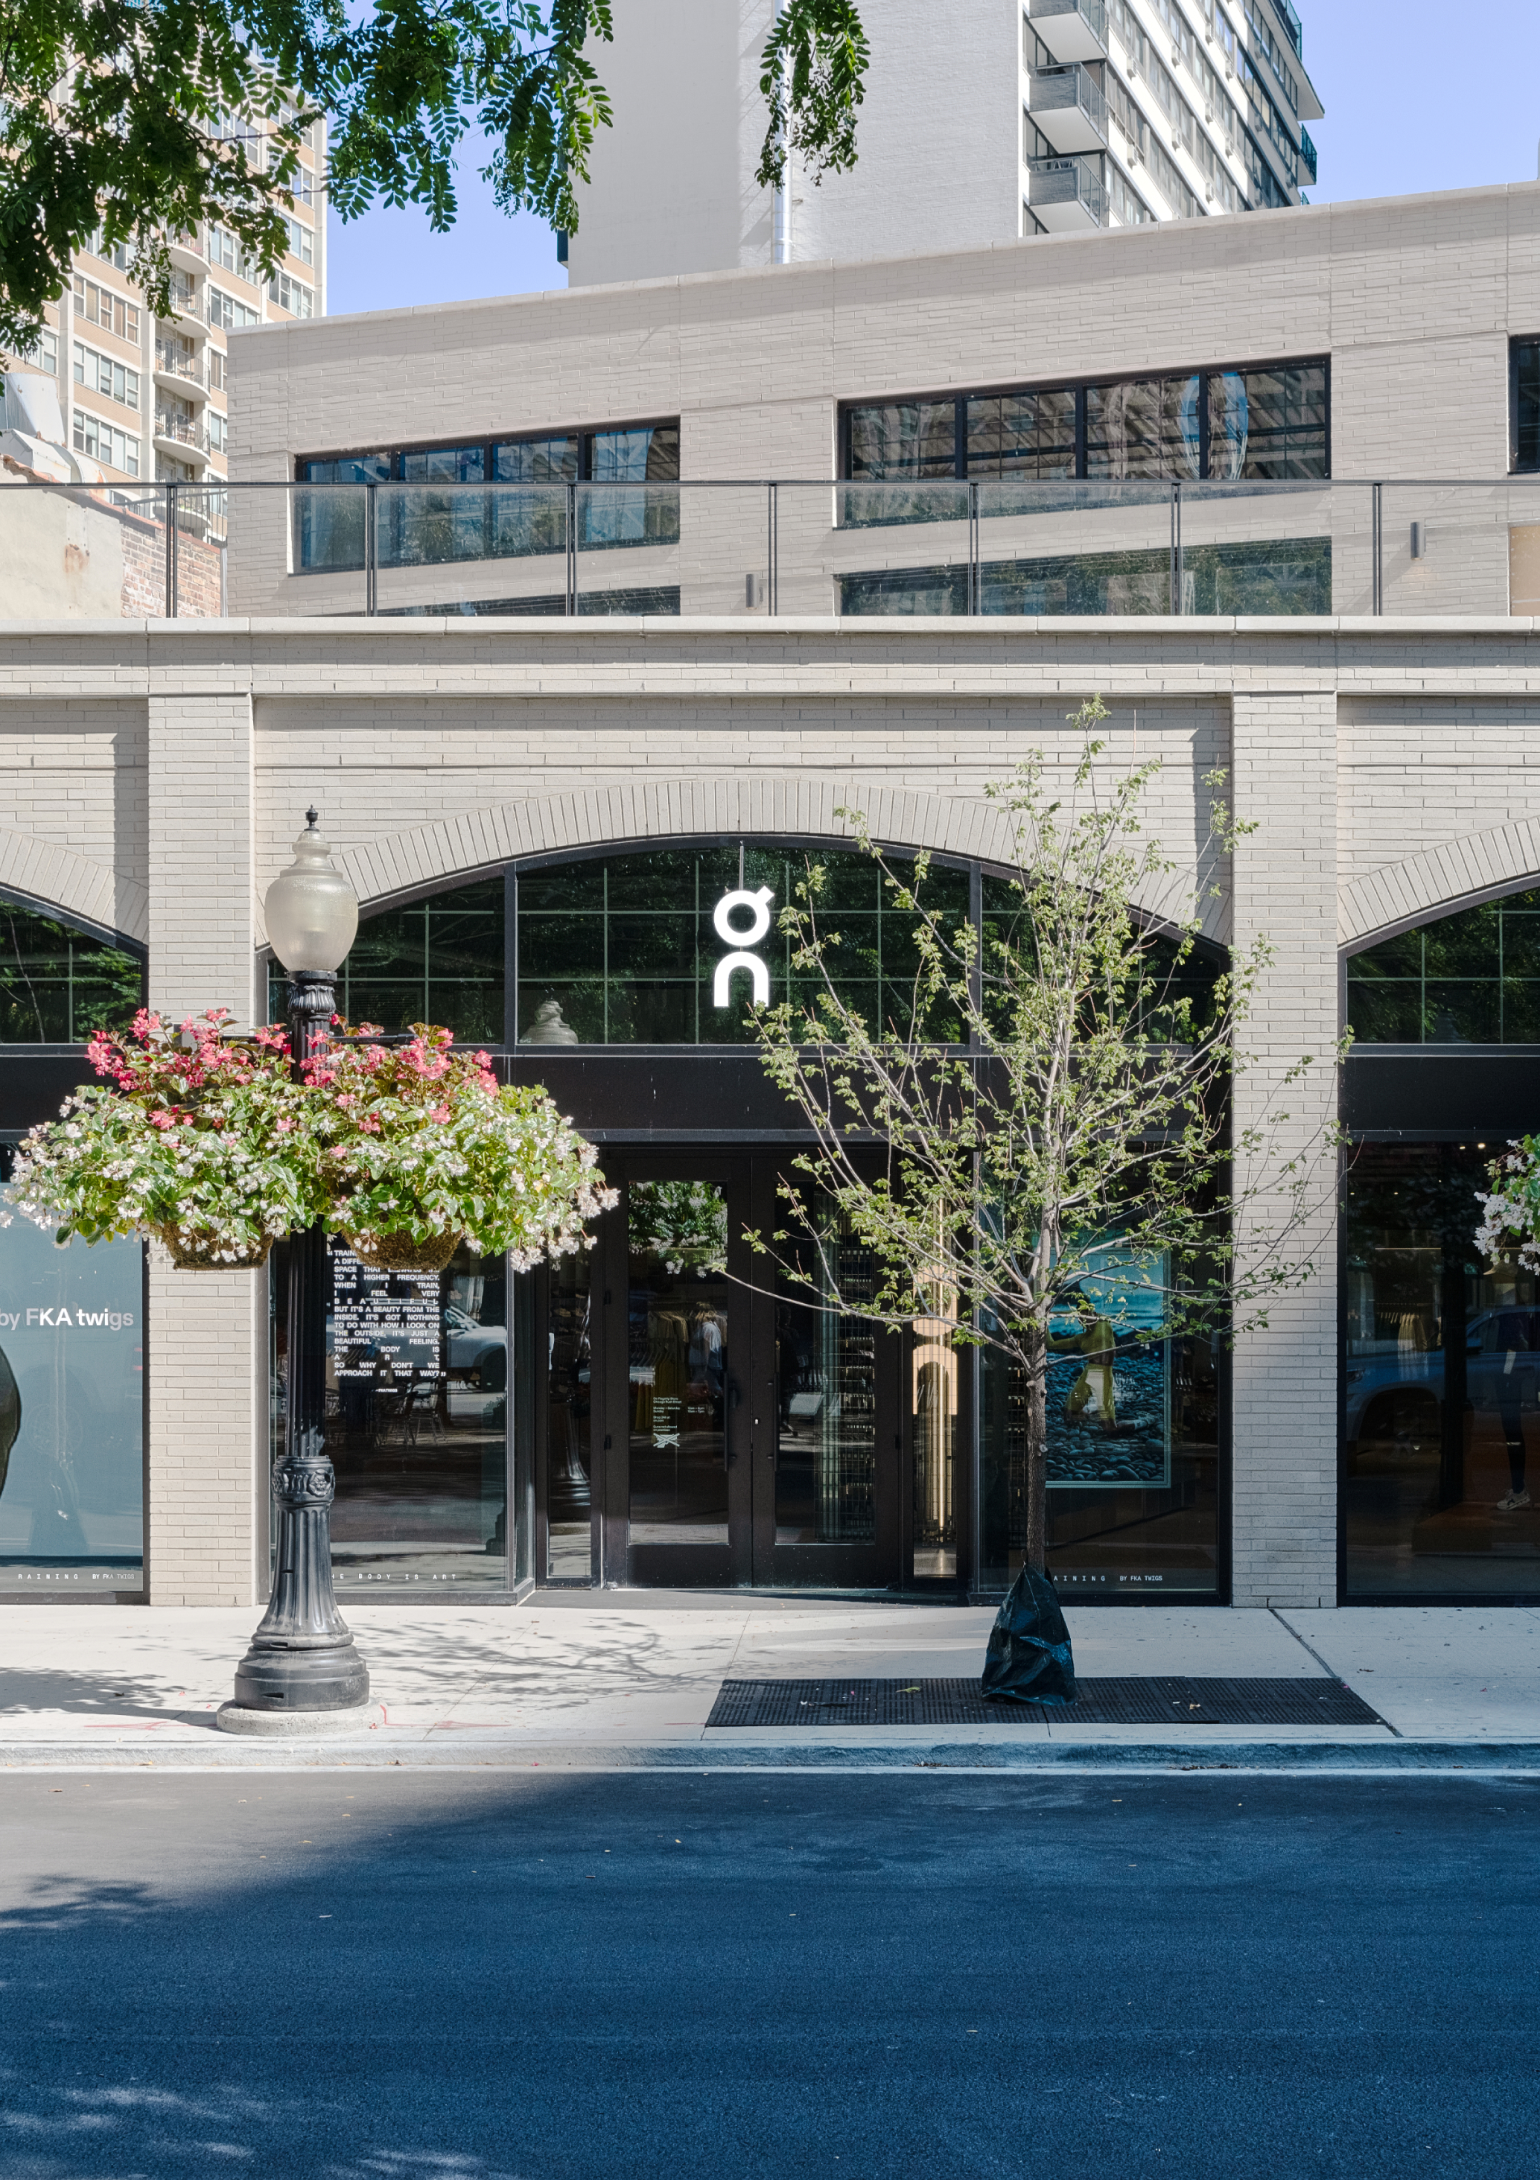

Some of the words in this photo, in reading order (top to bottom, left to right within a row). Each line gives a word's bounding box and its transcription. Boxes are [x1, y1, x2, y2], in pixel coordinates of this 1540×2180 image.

[0, 1308, 20, 1331] by
[26, 1308, 73, 1326] FKA
[76, 1308, 134, 1331] twigs
